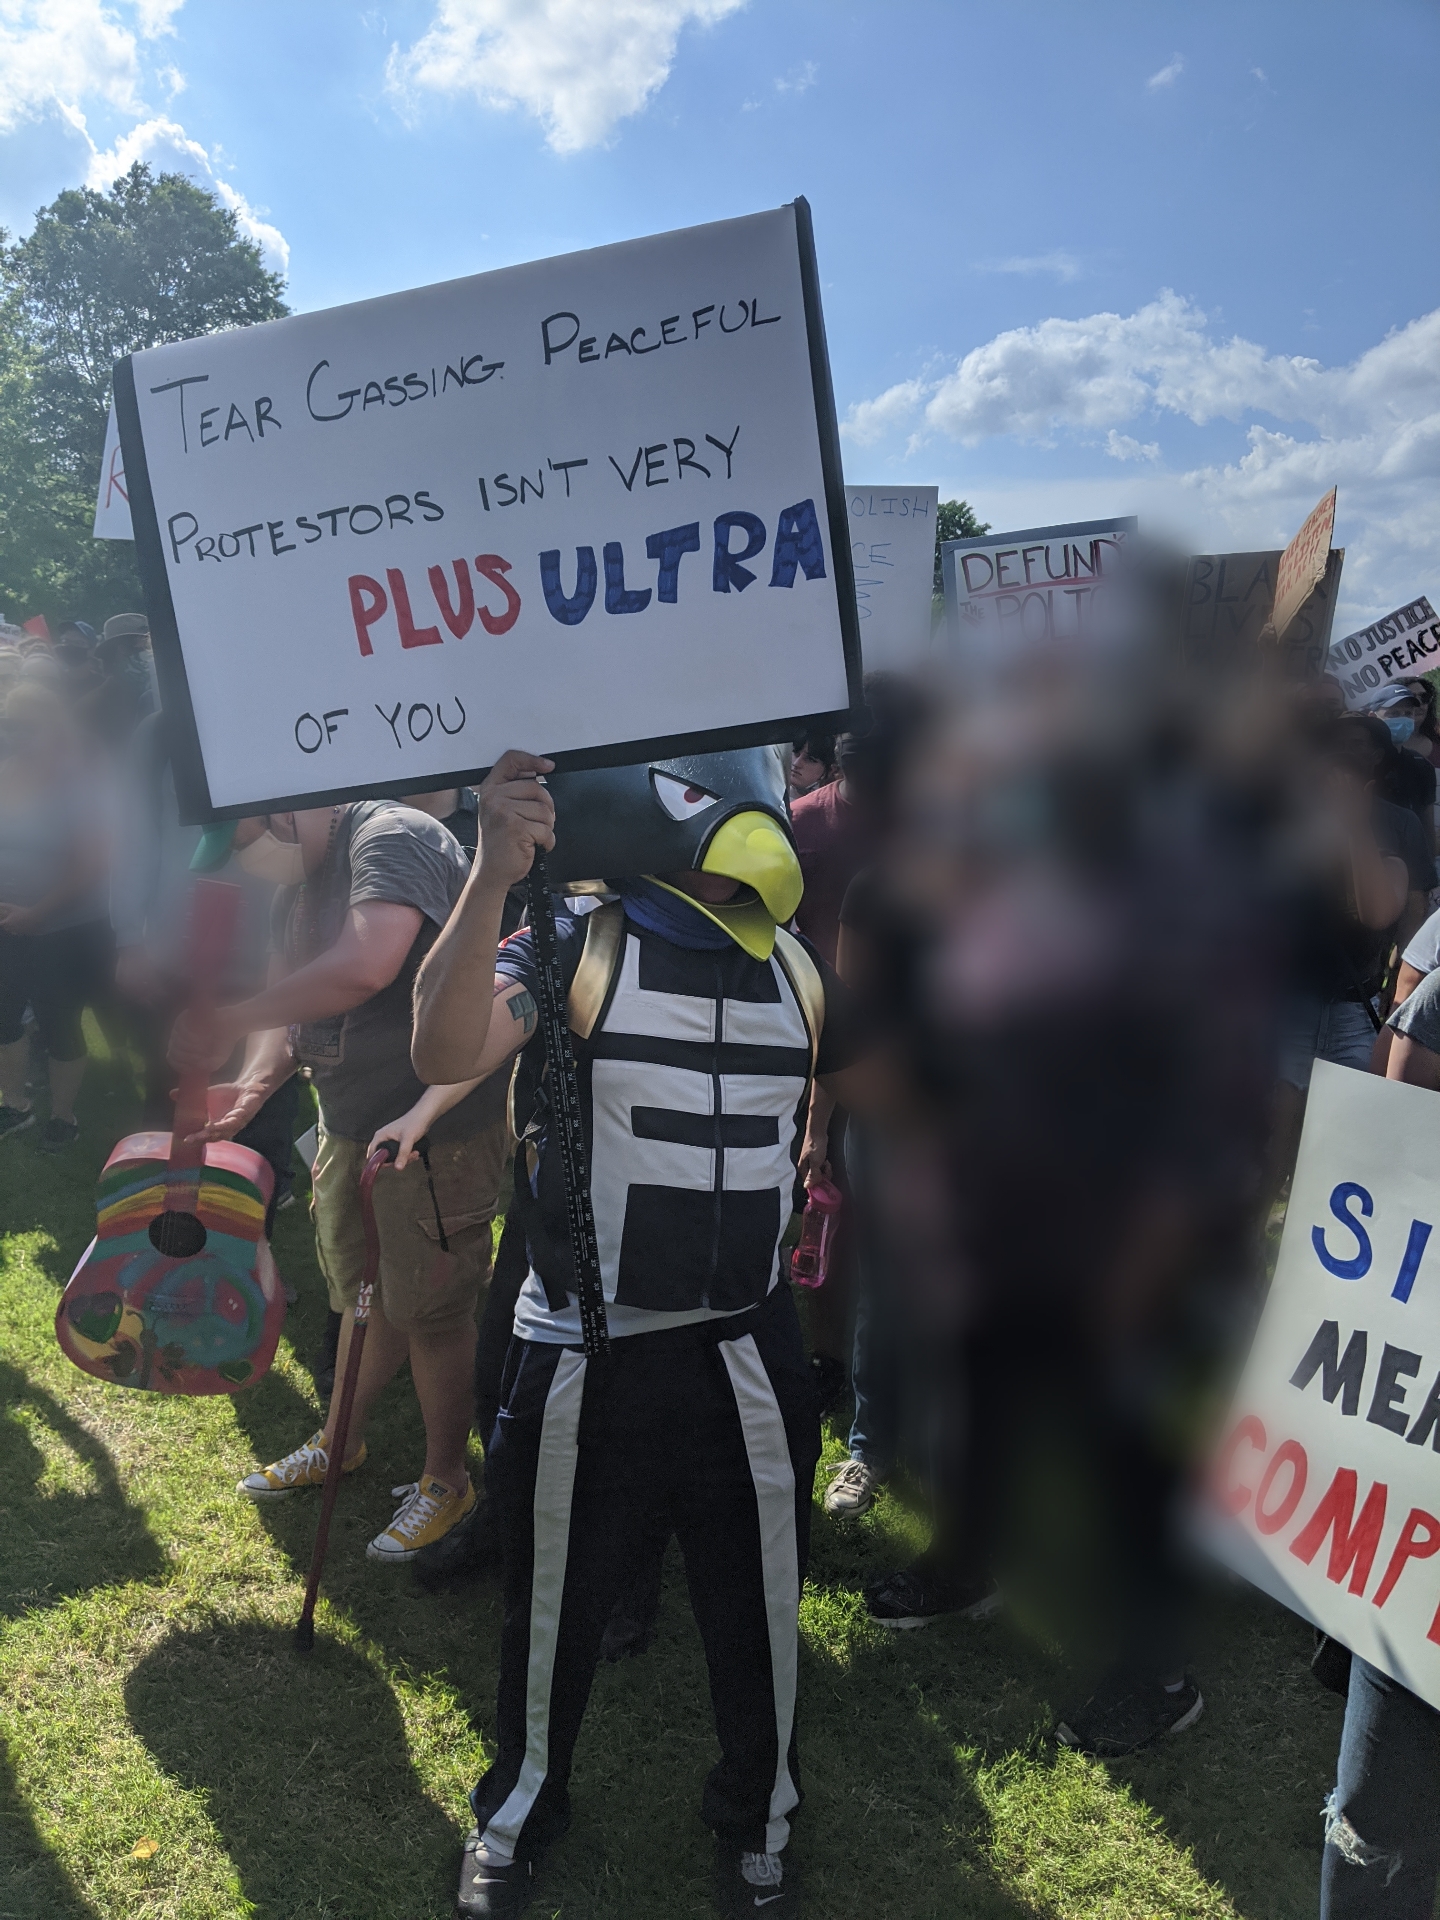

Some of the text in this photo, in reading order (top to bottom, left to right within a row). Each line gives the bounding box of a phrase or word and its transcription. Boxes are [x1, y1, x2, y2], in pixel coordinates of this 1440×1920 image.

[151, 298, 782, 453] TEAR GASSING PEACEFUL
[167, 426, 740, 564] PROTESTORS ISN'T VERY
[348, 499, 827, 657] PLUS ULTRA
[961, 538, 1123, 593] DEFUND
[1189, 558, 1327, 606] BLA
[1327, 637, 1363, 671] NO
[1360, 599, 1437, 651] JUSTICE
[1343, 664, 1380, 700] NO
[295, 697, 466, 754] OF YOU
[1215, 1413, 1440, 1646] COMP
